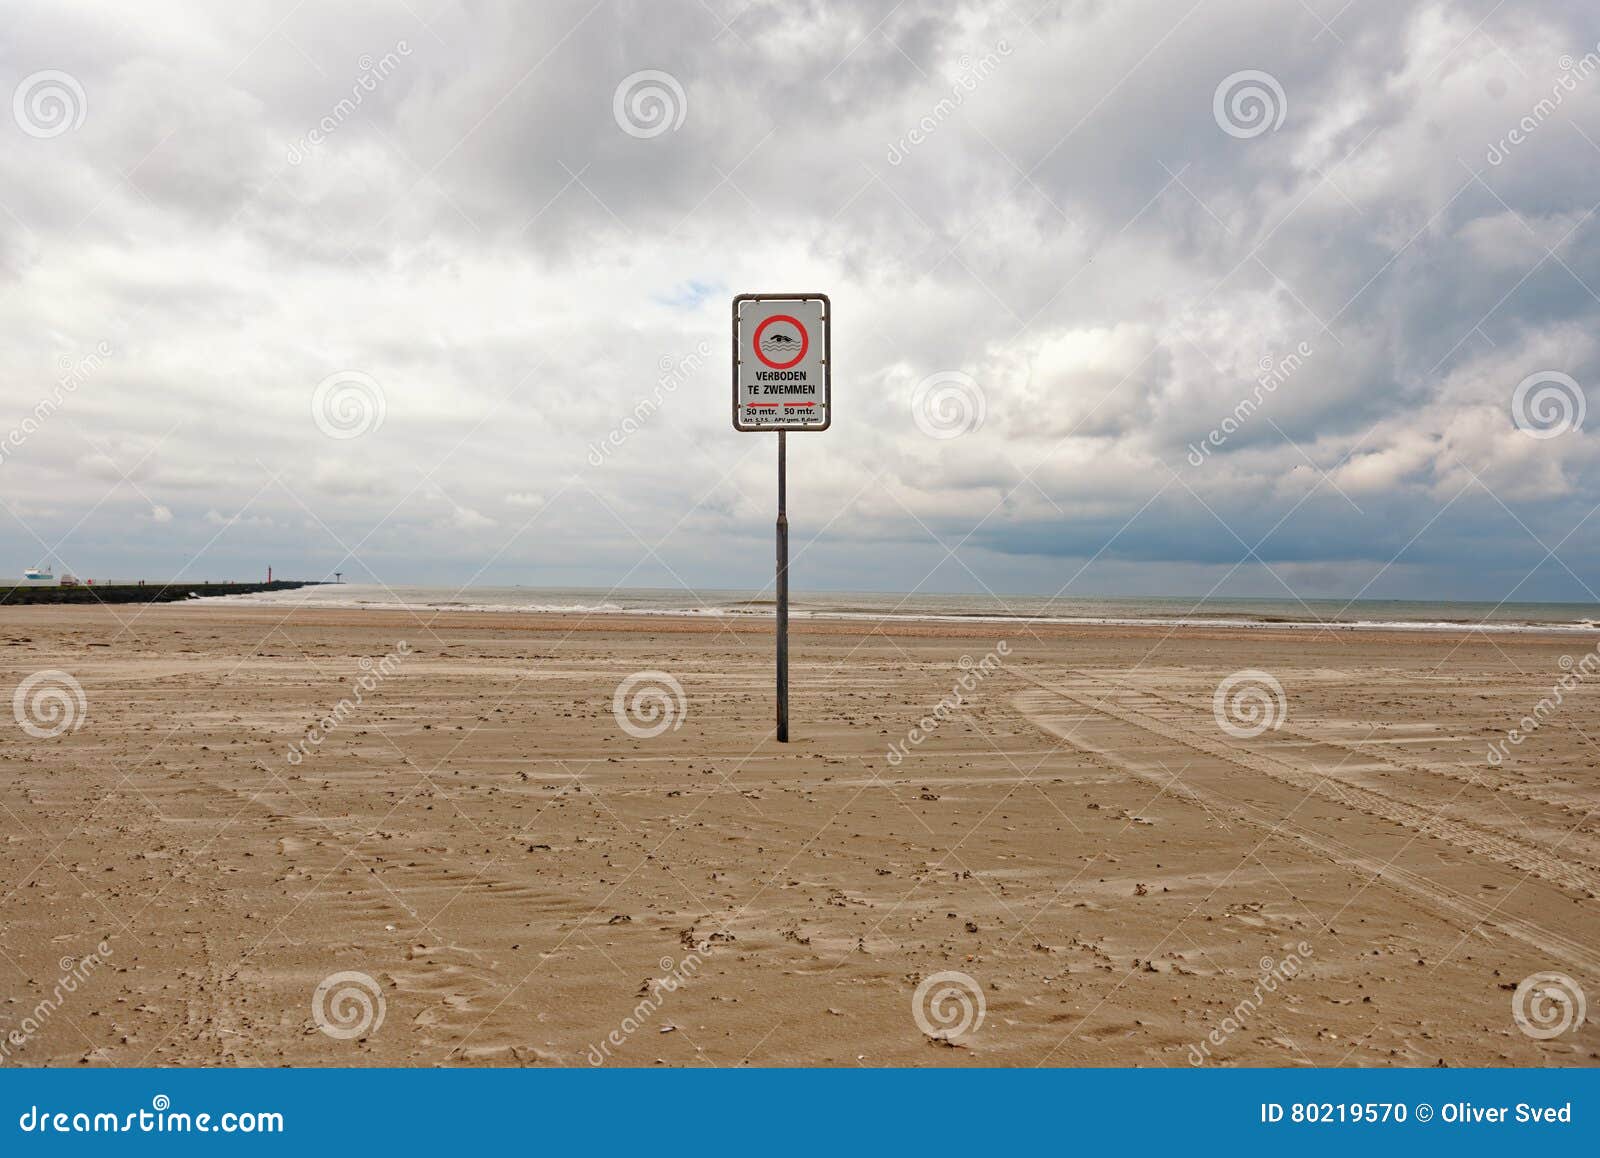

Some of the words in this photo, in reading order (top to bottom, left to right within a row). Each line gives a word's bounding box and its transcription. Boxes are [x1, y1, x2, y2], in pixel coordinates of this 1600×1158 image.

[755, 371, 807, 381] VERBODEN
[748, 385, 760, 395] TE
[763, 385, 815, 395] ZWEMMEN
[784, 407, 795, 415] 50
[797, 407, 815, 415] mtr.
